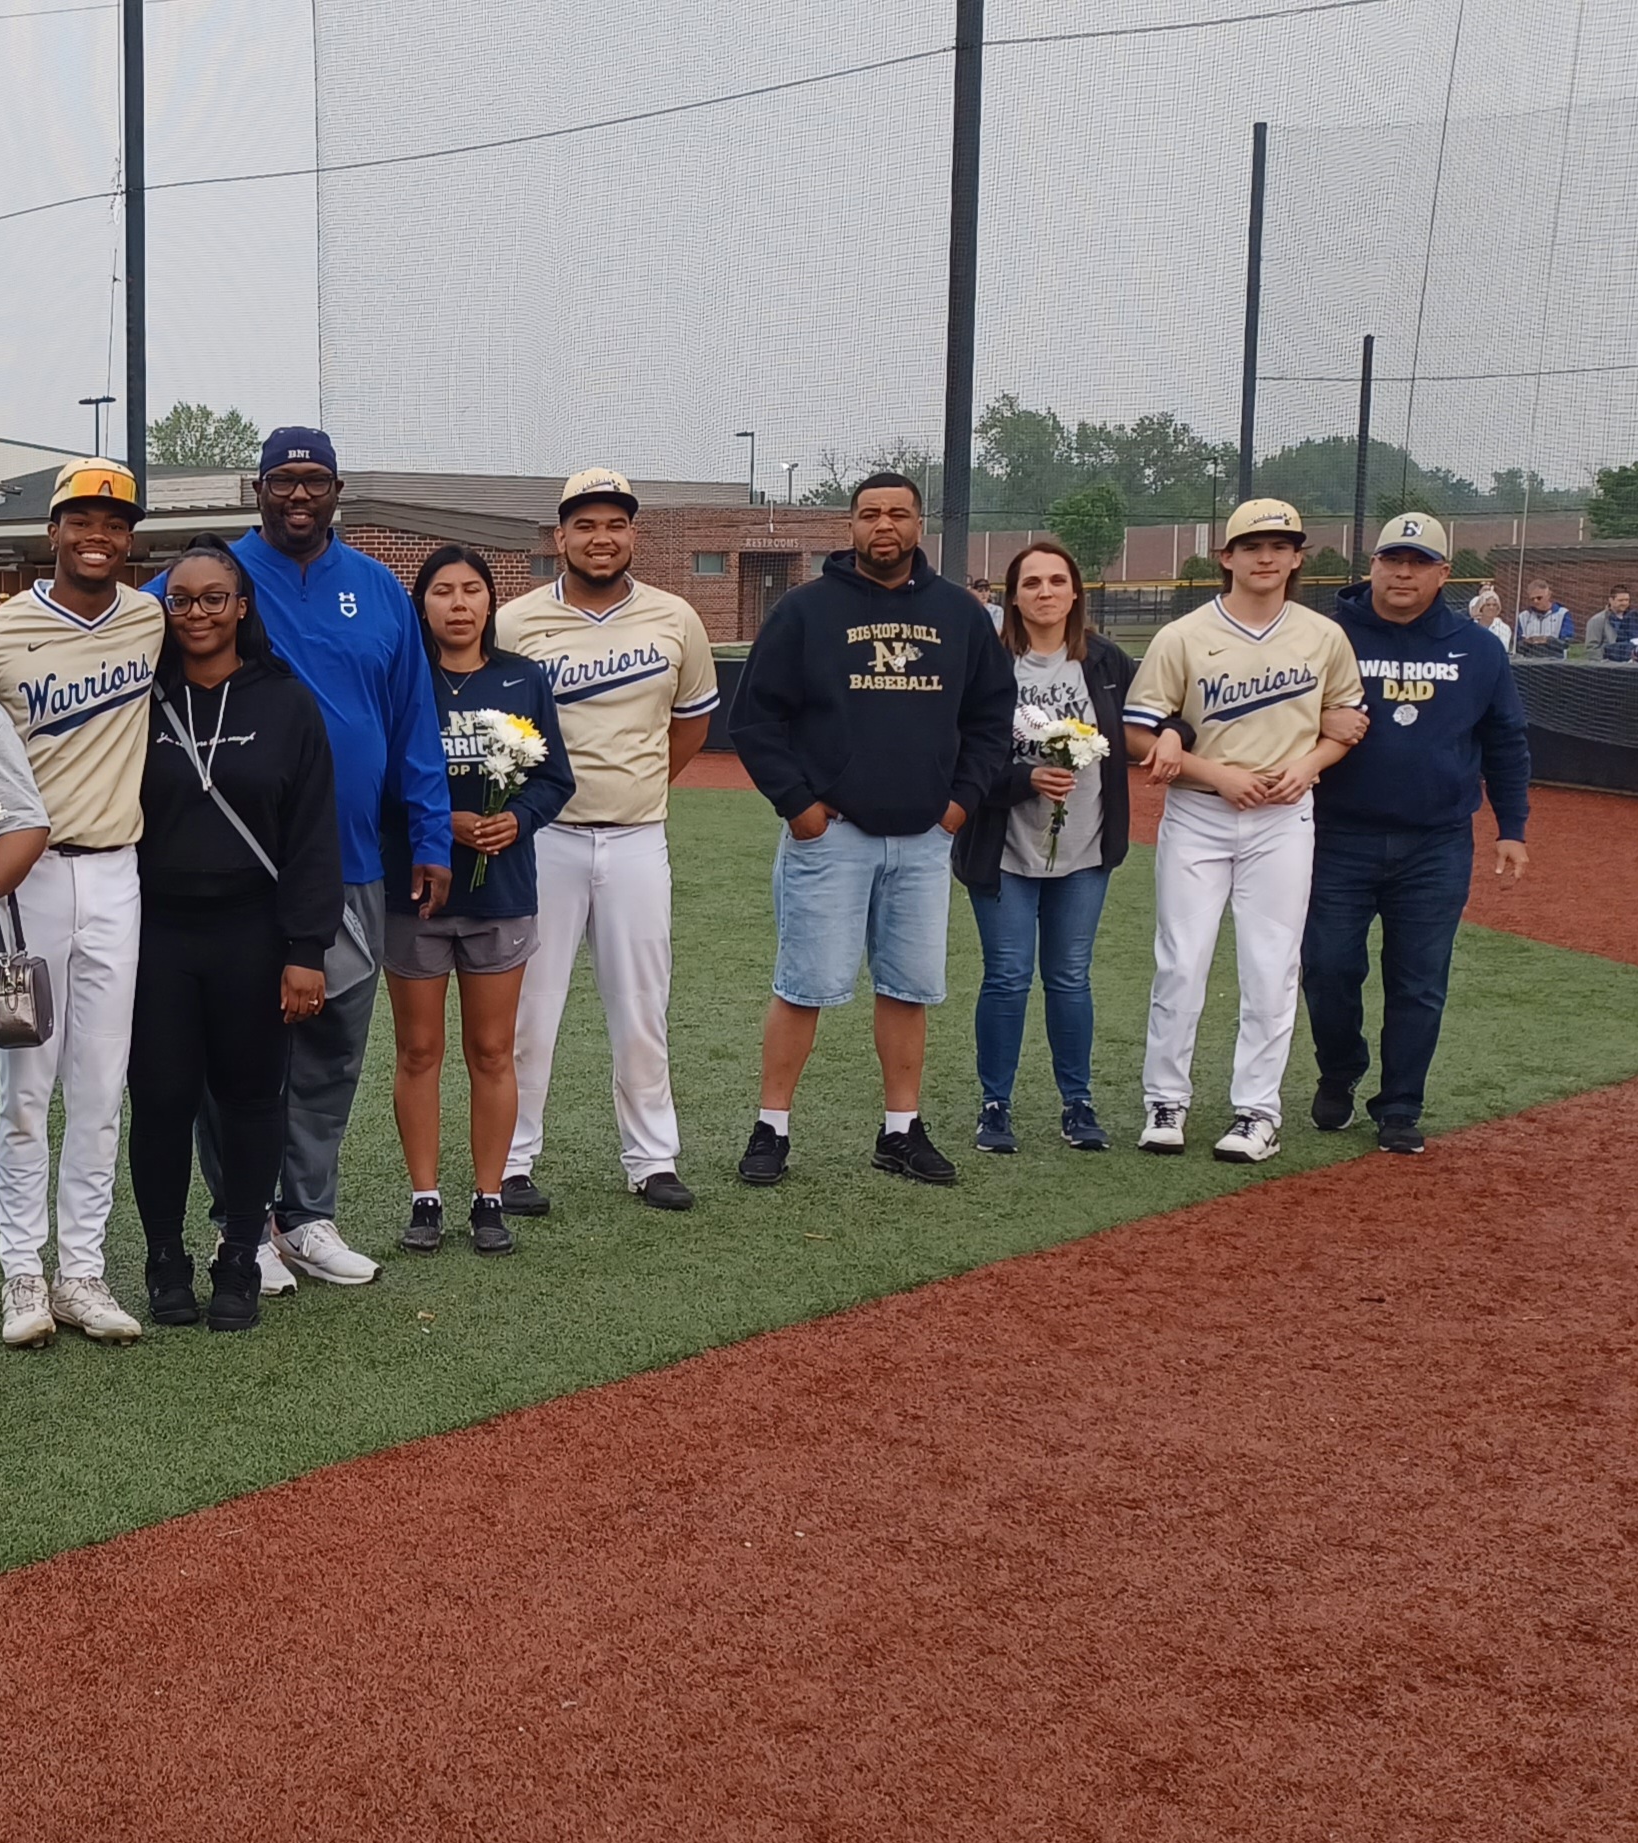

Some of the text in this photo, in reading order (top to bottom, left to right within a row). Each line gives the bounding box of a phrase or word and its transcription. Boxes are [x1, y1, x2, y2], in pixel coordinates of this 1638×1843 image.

[287, 449, 311, 459] BNI
[745, 538, 799, 548] RESTROOMS
[846, 623, 942, 644] BISHOP NOLL
[536, 642, 670, 690] Warriors
[1358, 660, 1459, 681] WARRIORS
[18, 653, 154, 726] Warriors
[849, 674, 943, 691] BASEBALL
[1197, 663, 1319, 711] Warriors
[1383, 679, 1435, 702] DAD
[1055, 701, 1088, 725] MY
